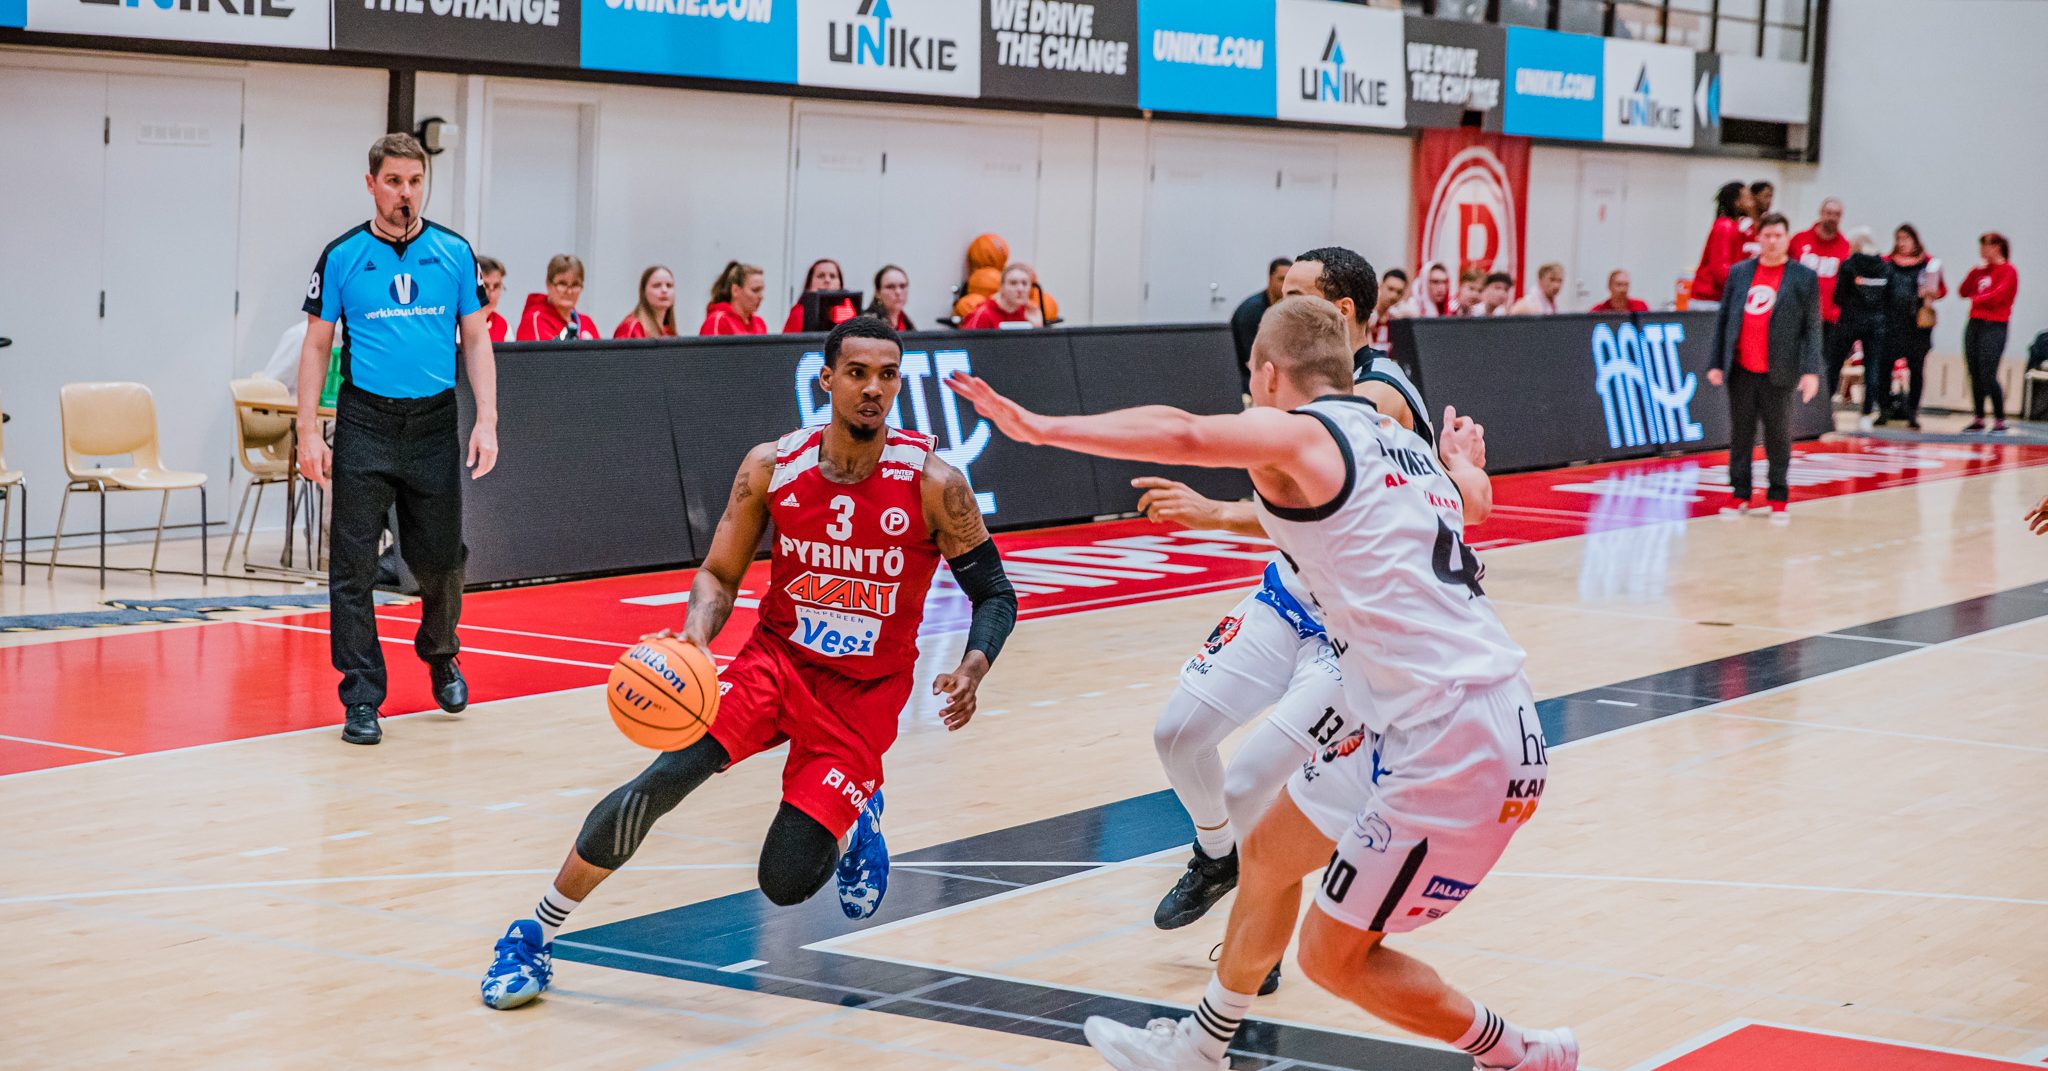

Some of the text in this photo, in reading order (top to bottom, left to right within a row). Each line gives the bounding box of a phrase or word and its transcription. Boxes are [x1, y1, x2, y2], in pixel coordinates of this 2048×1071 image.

[990, 0, 1095, 38] WE DRIVE
[829, 21, 957, 72] UNIKIE
[996, 30, 1128, 75] THE CHANGE
[1153, 29, 1264, 69] UNIKIE.COM
[1301, 66, 1388, 106] UNIKIE
[893, 474, 913, 482] SPORT
[894, 468, 914, 476] INTER
[826, 494, 855, 541] 3
[780, 533, 905, 577] PYRINTÖ
[787, 574, 895, 614] AVANT
[800, 607, 864, 624] TAMPEREEN
[800, 616, 874, 655] Vesi
[629, 645, 686, 693] Wilson
[1308, 706, 1345, 746] 13
